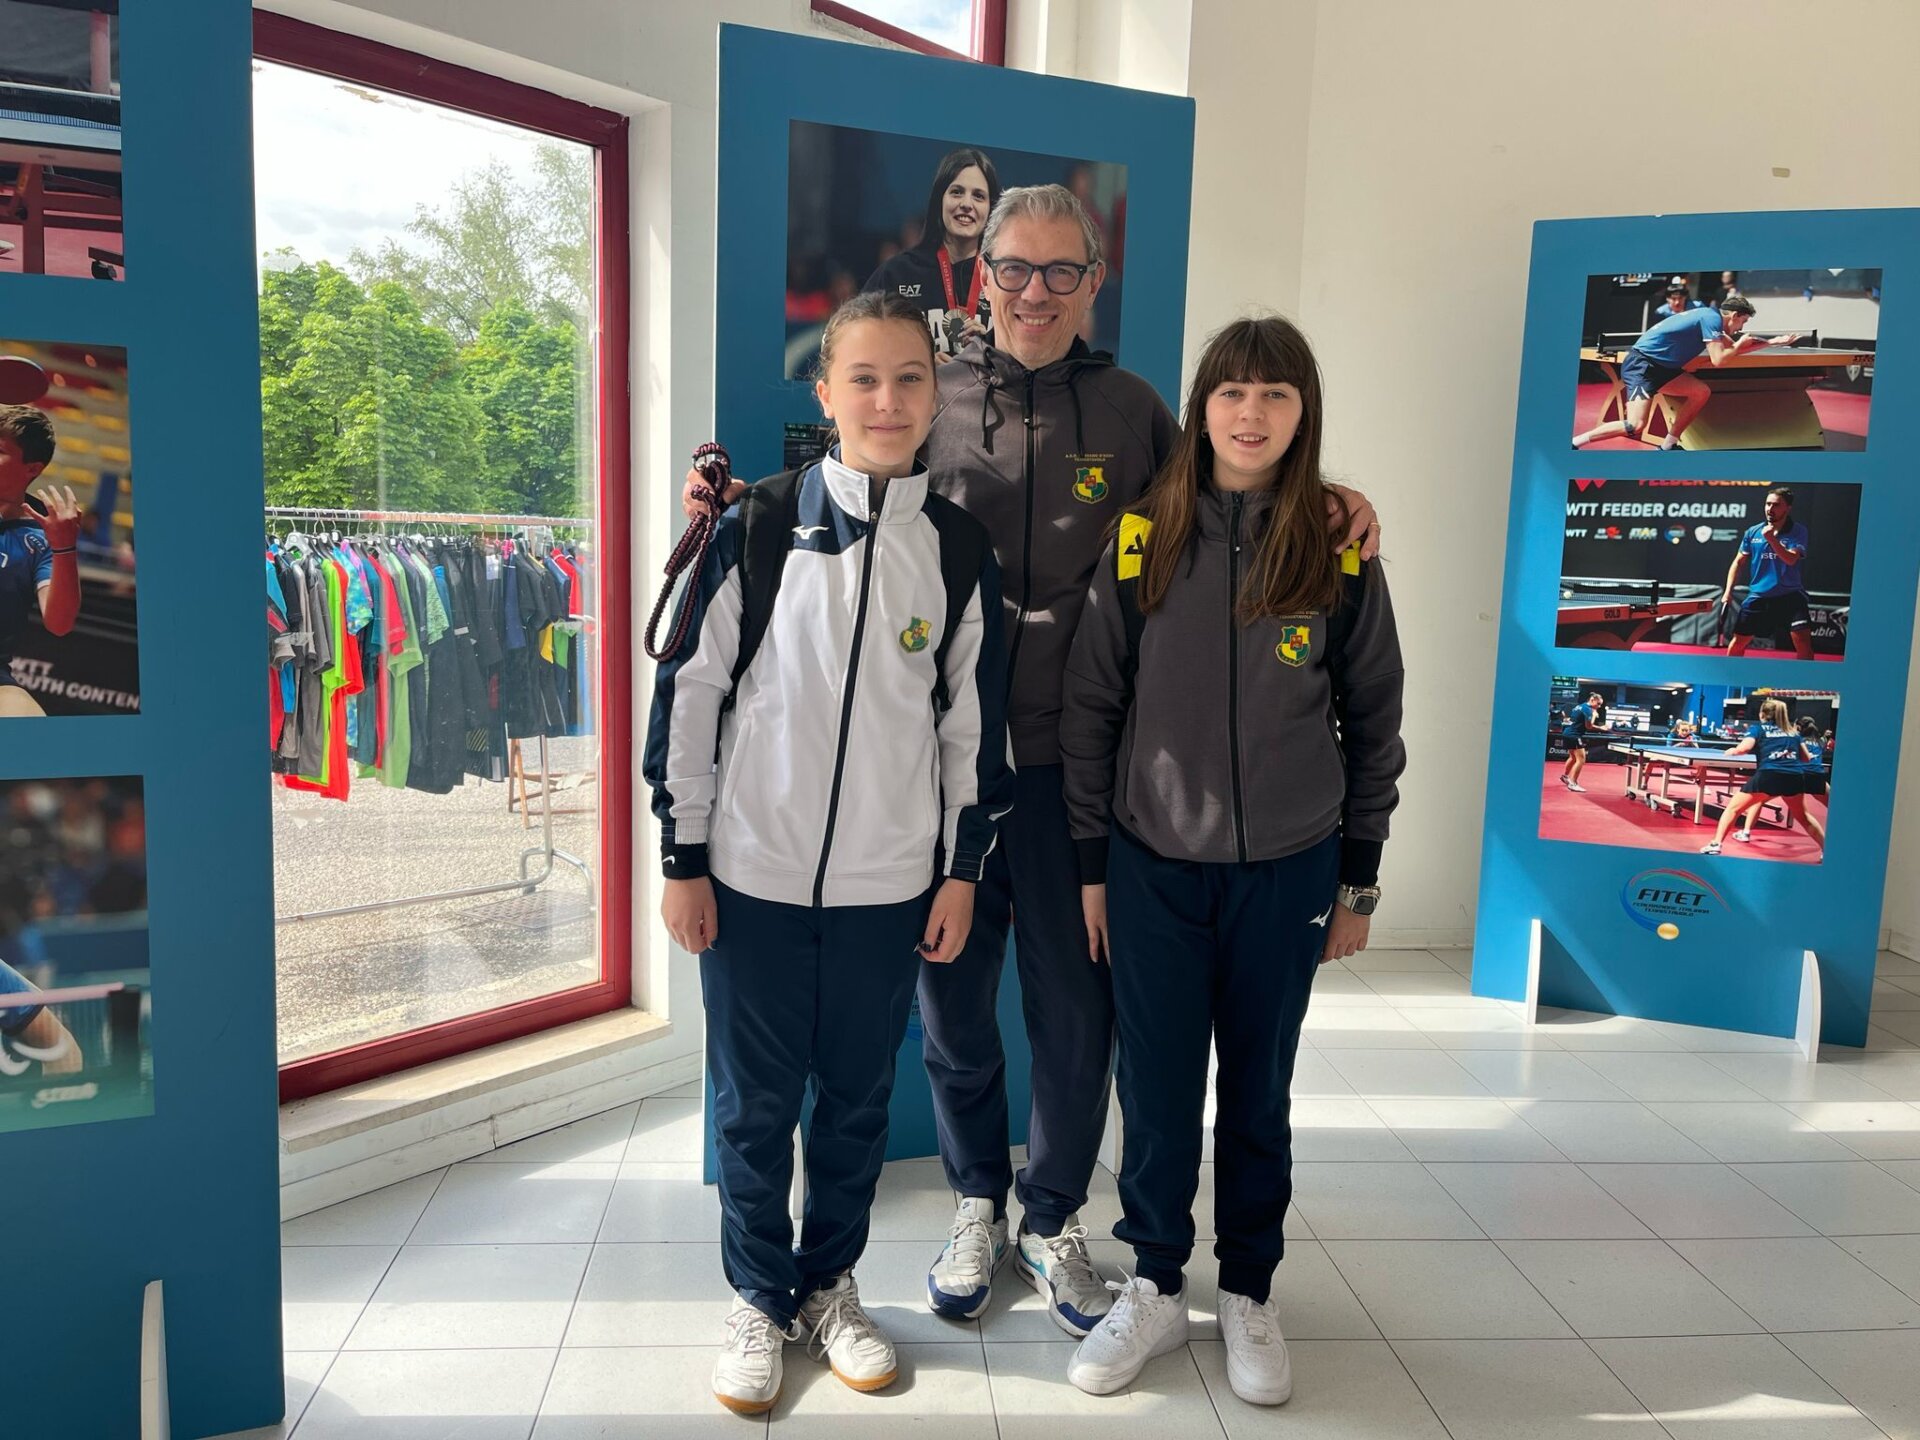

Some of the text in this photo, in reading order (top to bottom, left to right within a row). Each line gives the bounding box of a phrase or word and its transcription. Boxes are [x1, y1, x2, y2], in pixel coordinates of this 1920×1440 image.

[899, 284, 921, 295] EA7
[1566, 503, 1747, 518] WTT FEEDER CAGLIARI
[1565, 528, 1587, 537] WTT
[1637, 888, 1707, 906] FITET
